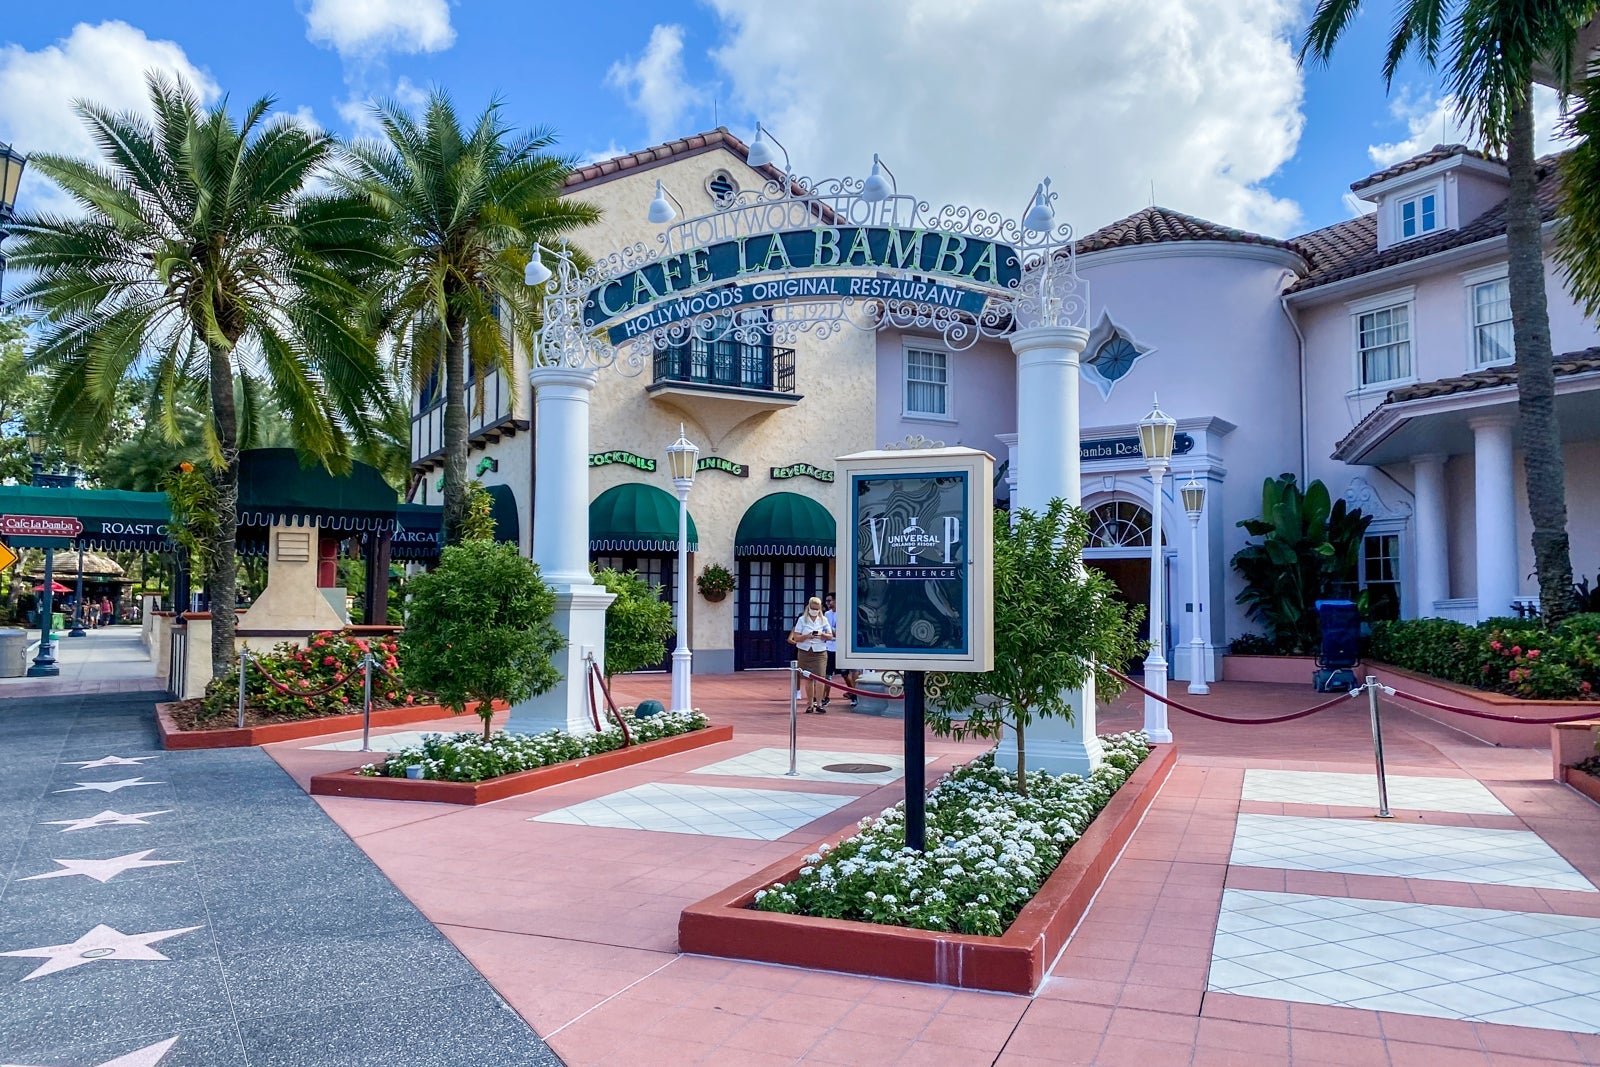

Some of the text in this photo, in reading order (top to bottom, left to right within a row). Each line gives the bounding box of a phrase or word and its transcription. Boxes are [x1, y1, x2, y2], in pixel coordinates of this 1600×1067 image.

[680, 198, 900, 250] HOLLYWOOD HOTEL
[598, 227, 1000, 317] CAFE LA BAMBA
[625, 278, 966, 337] HOLLYWOOD'S ORIGINAL RESTAURANT
[588, 451, 655, 471] COCKTAILS
[773, 464, 835, 481] BEVERAGES
[30, 519, 41, 529] La
[42, 519, 73, 530] Bamba
[101, 522, 153, 535] ROAST
[888, 534, 940, 544] UNIVERSAL
